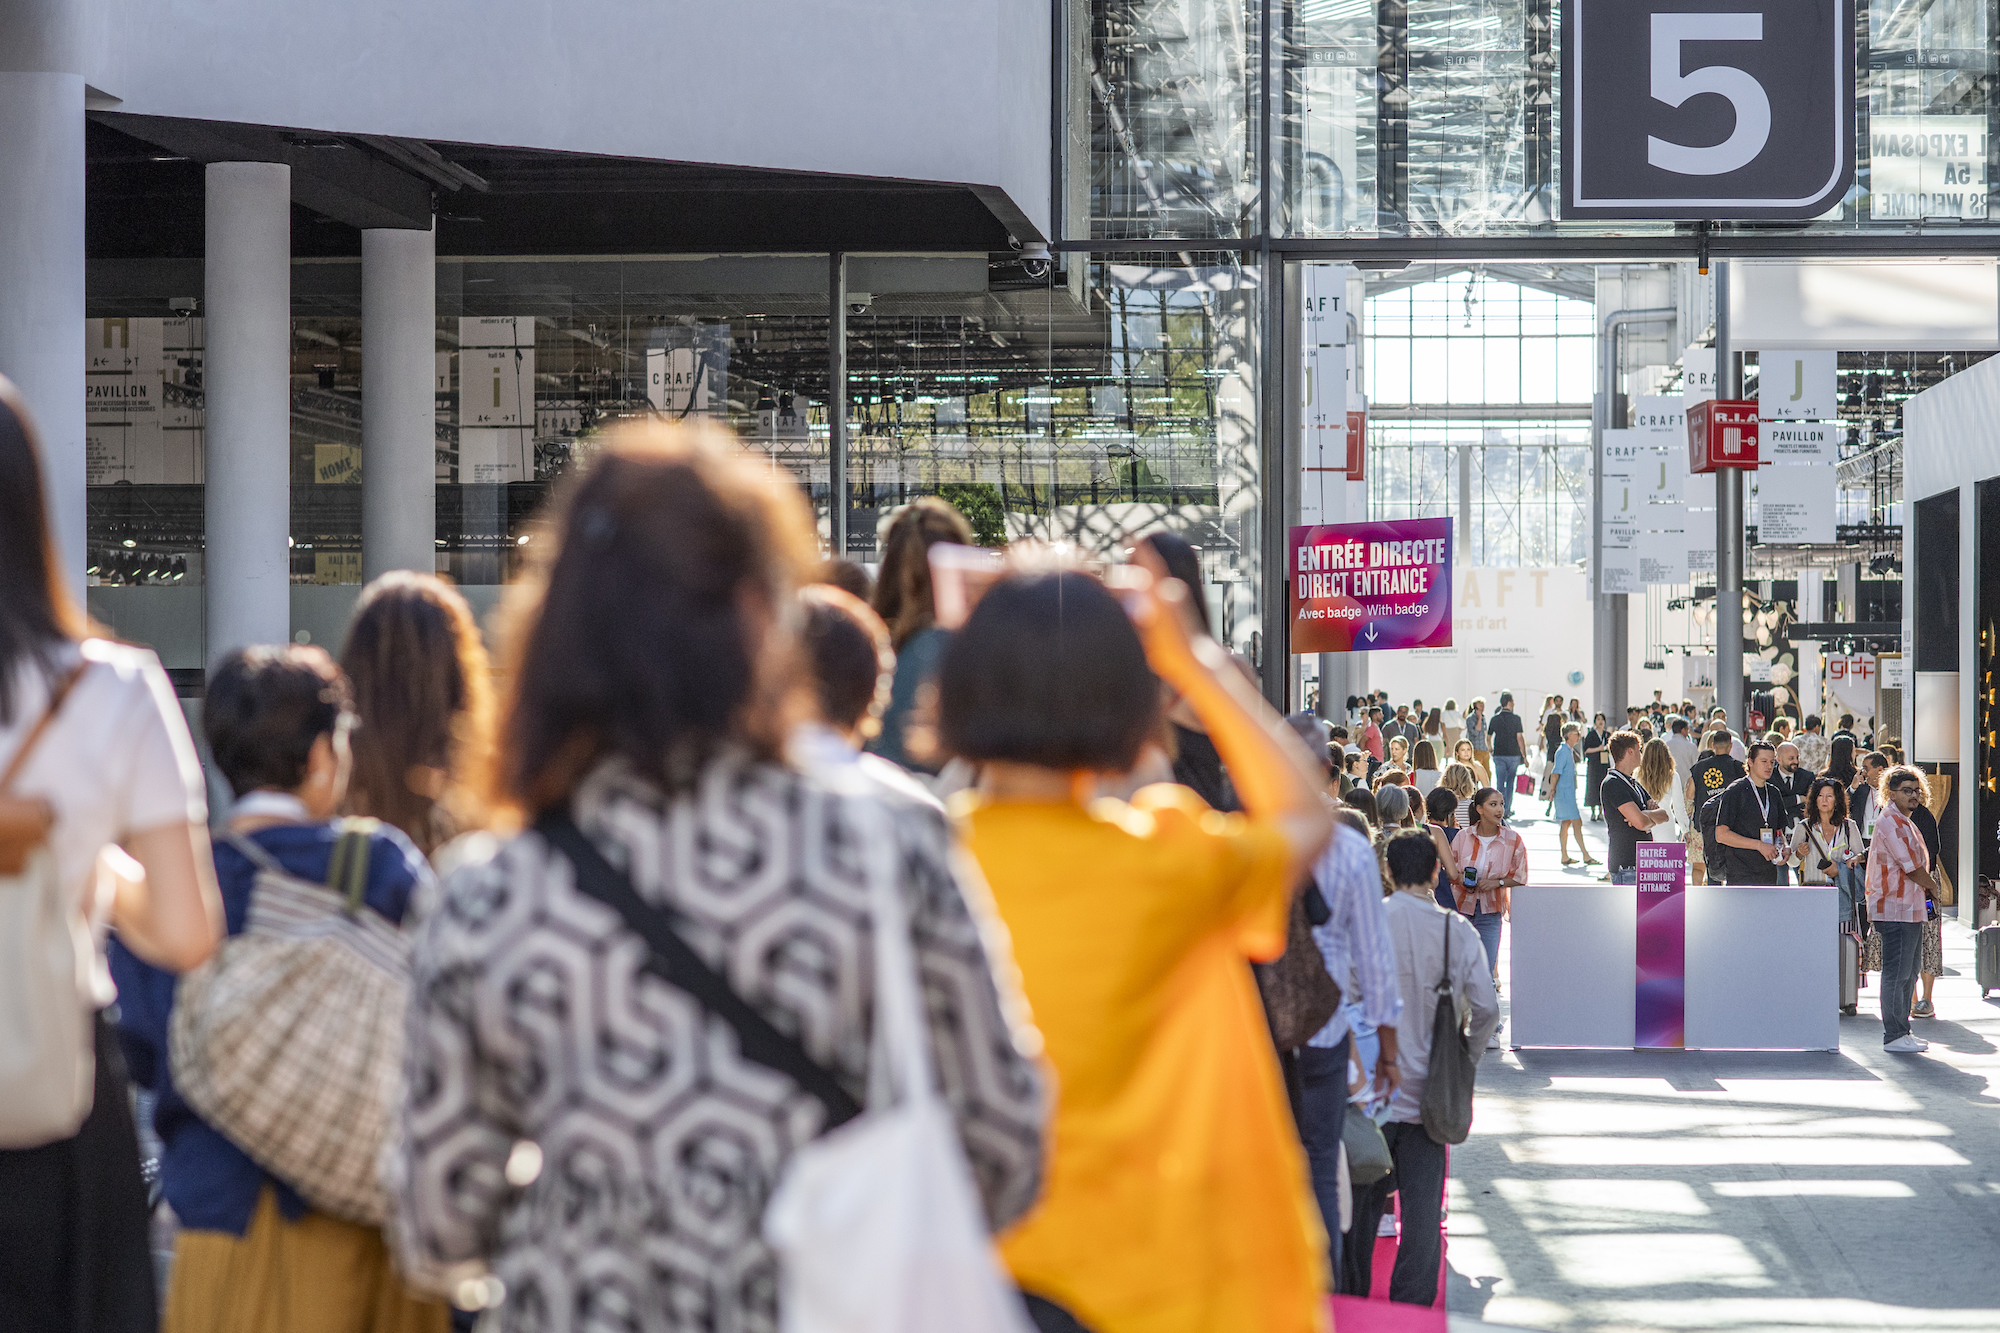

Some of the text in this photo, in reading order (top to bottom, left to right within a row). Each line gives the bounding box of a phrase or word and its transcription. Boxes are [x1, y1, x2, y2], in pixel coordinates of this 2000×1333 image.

[1648, 12, 1772, 176] 5
[653, 373, 699, 385] CRAF
[1790, 360, 1803, 401] J
[86, 385, 147, 398] PAVILLON
[1778, 408, 1816, 416] A T
[1640, 415, 1683, 426] CRAFT
[1772, 431, 1824, 441] PAVILLON
[319, 456, 354, 481] HOME
[1657, 462, 1665, 490] J
[1621, 488, 1628, 512] J
[1298, 538, 1445, 571] ENTRÉE DIRECTE
[1298, 568, 1428, 599] DIRECT ENTRANCE
[1460, 571, 1549, 607] AFT
[1298, 603, 1429, 620] Avec badge With badge
[1477, 616, 1507, 630] d'art
[1640, 847, 1667, 858] ENTRÉE
[1640, 859, 1683, 869] EXPOSANTS
[1640, 872, 1676, 882] EXHIBITORS
[1640, 883, 1671, 892] ENTRANCE
